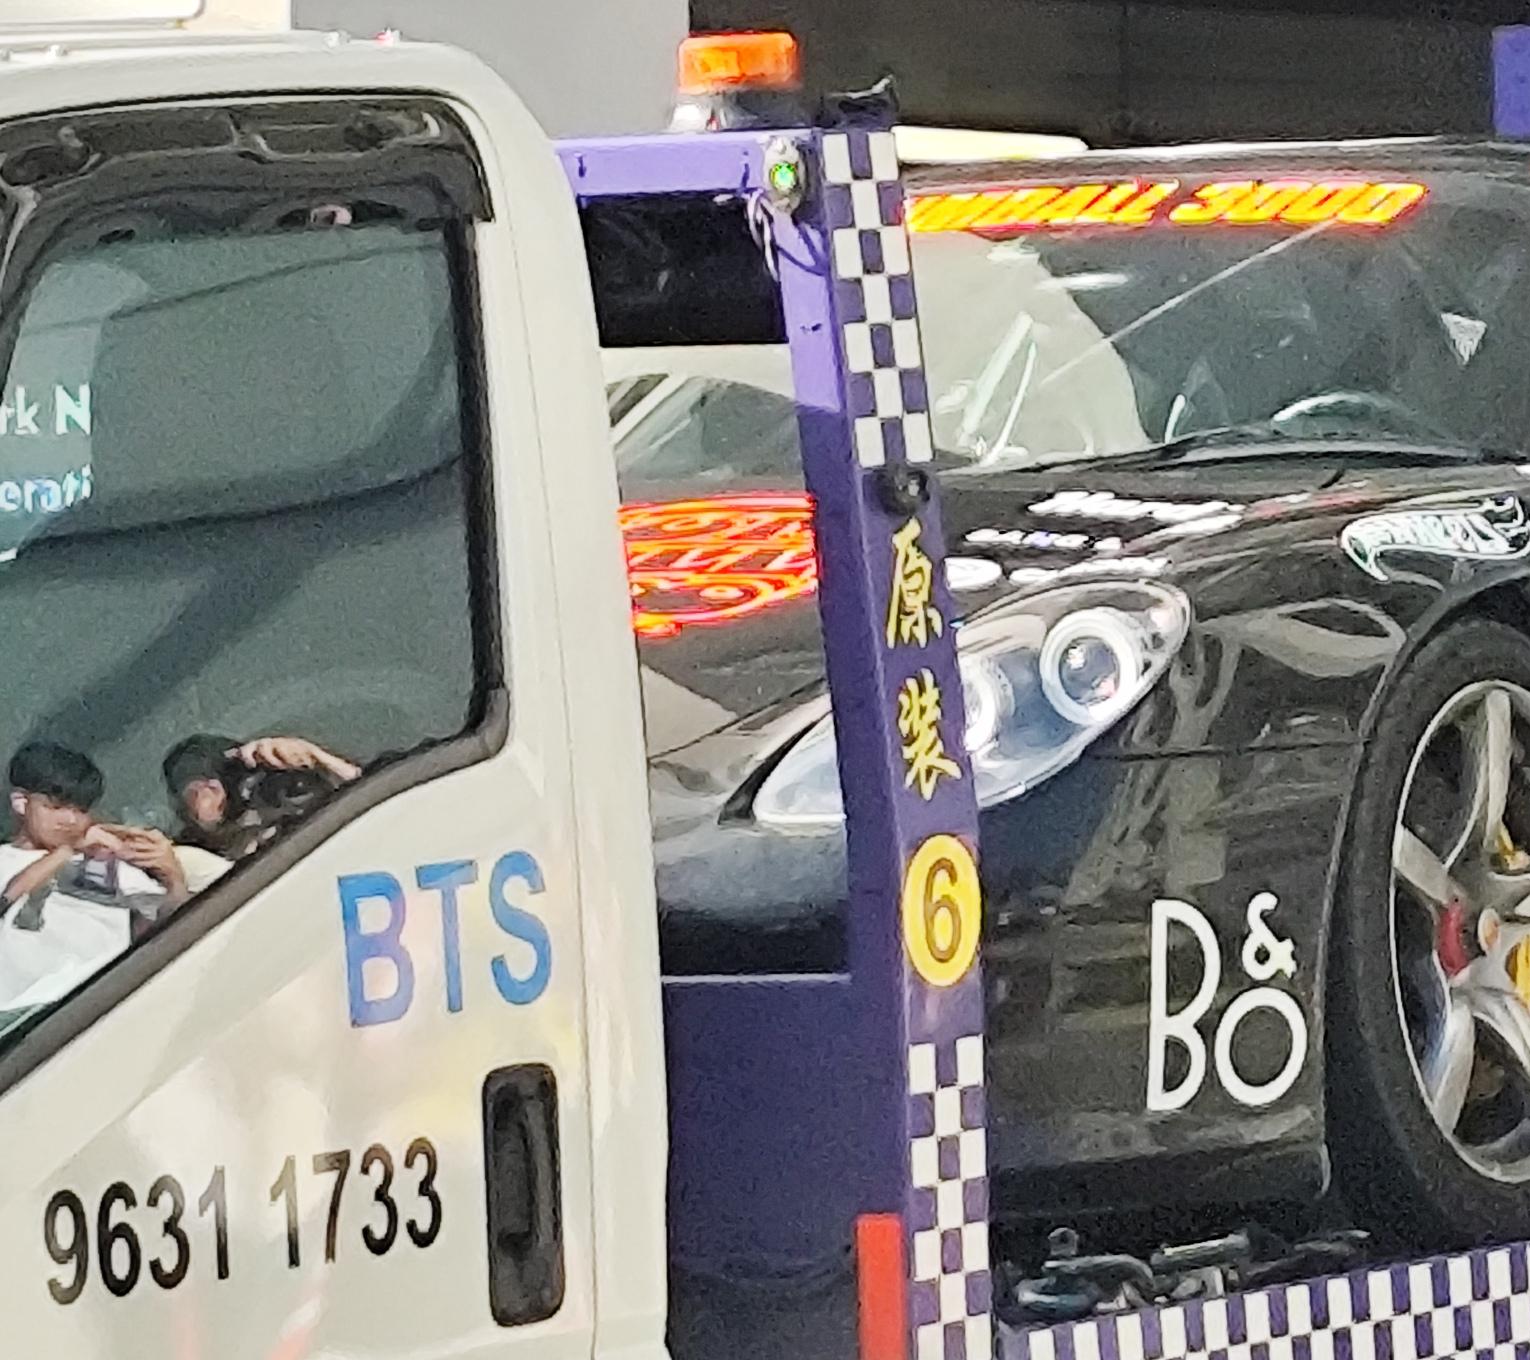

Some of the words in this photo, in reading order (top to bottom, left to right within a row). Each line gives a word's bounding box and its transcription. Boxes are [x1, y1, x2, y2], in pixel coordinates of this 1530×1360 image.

[1168, 179, 1429, 225] 3000
[337, 850, 552, 1028] BTS
[922, 856, 963, 964] 6
[44, 1164, 230, 1306] 9631
[269, 1136, 443, 1270] 1733
